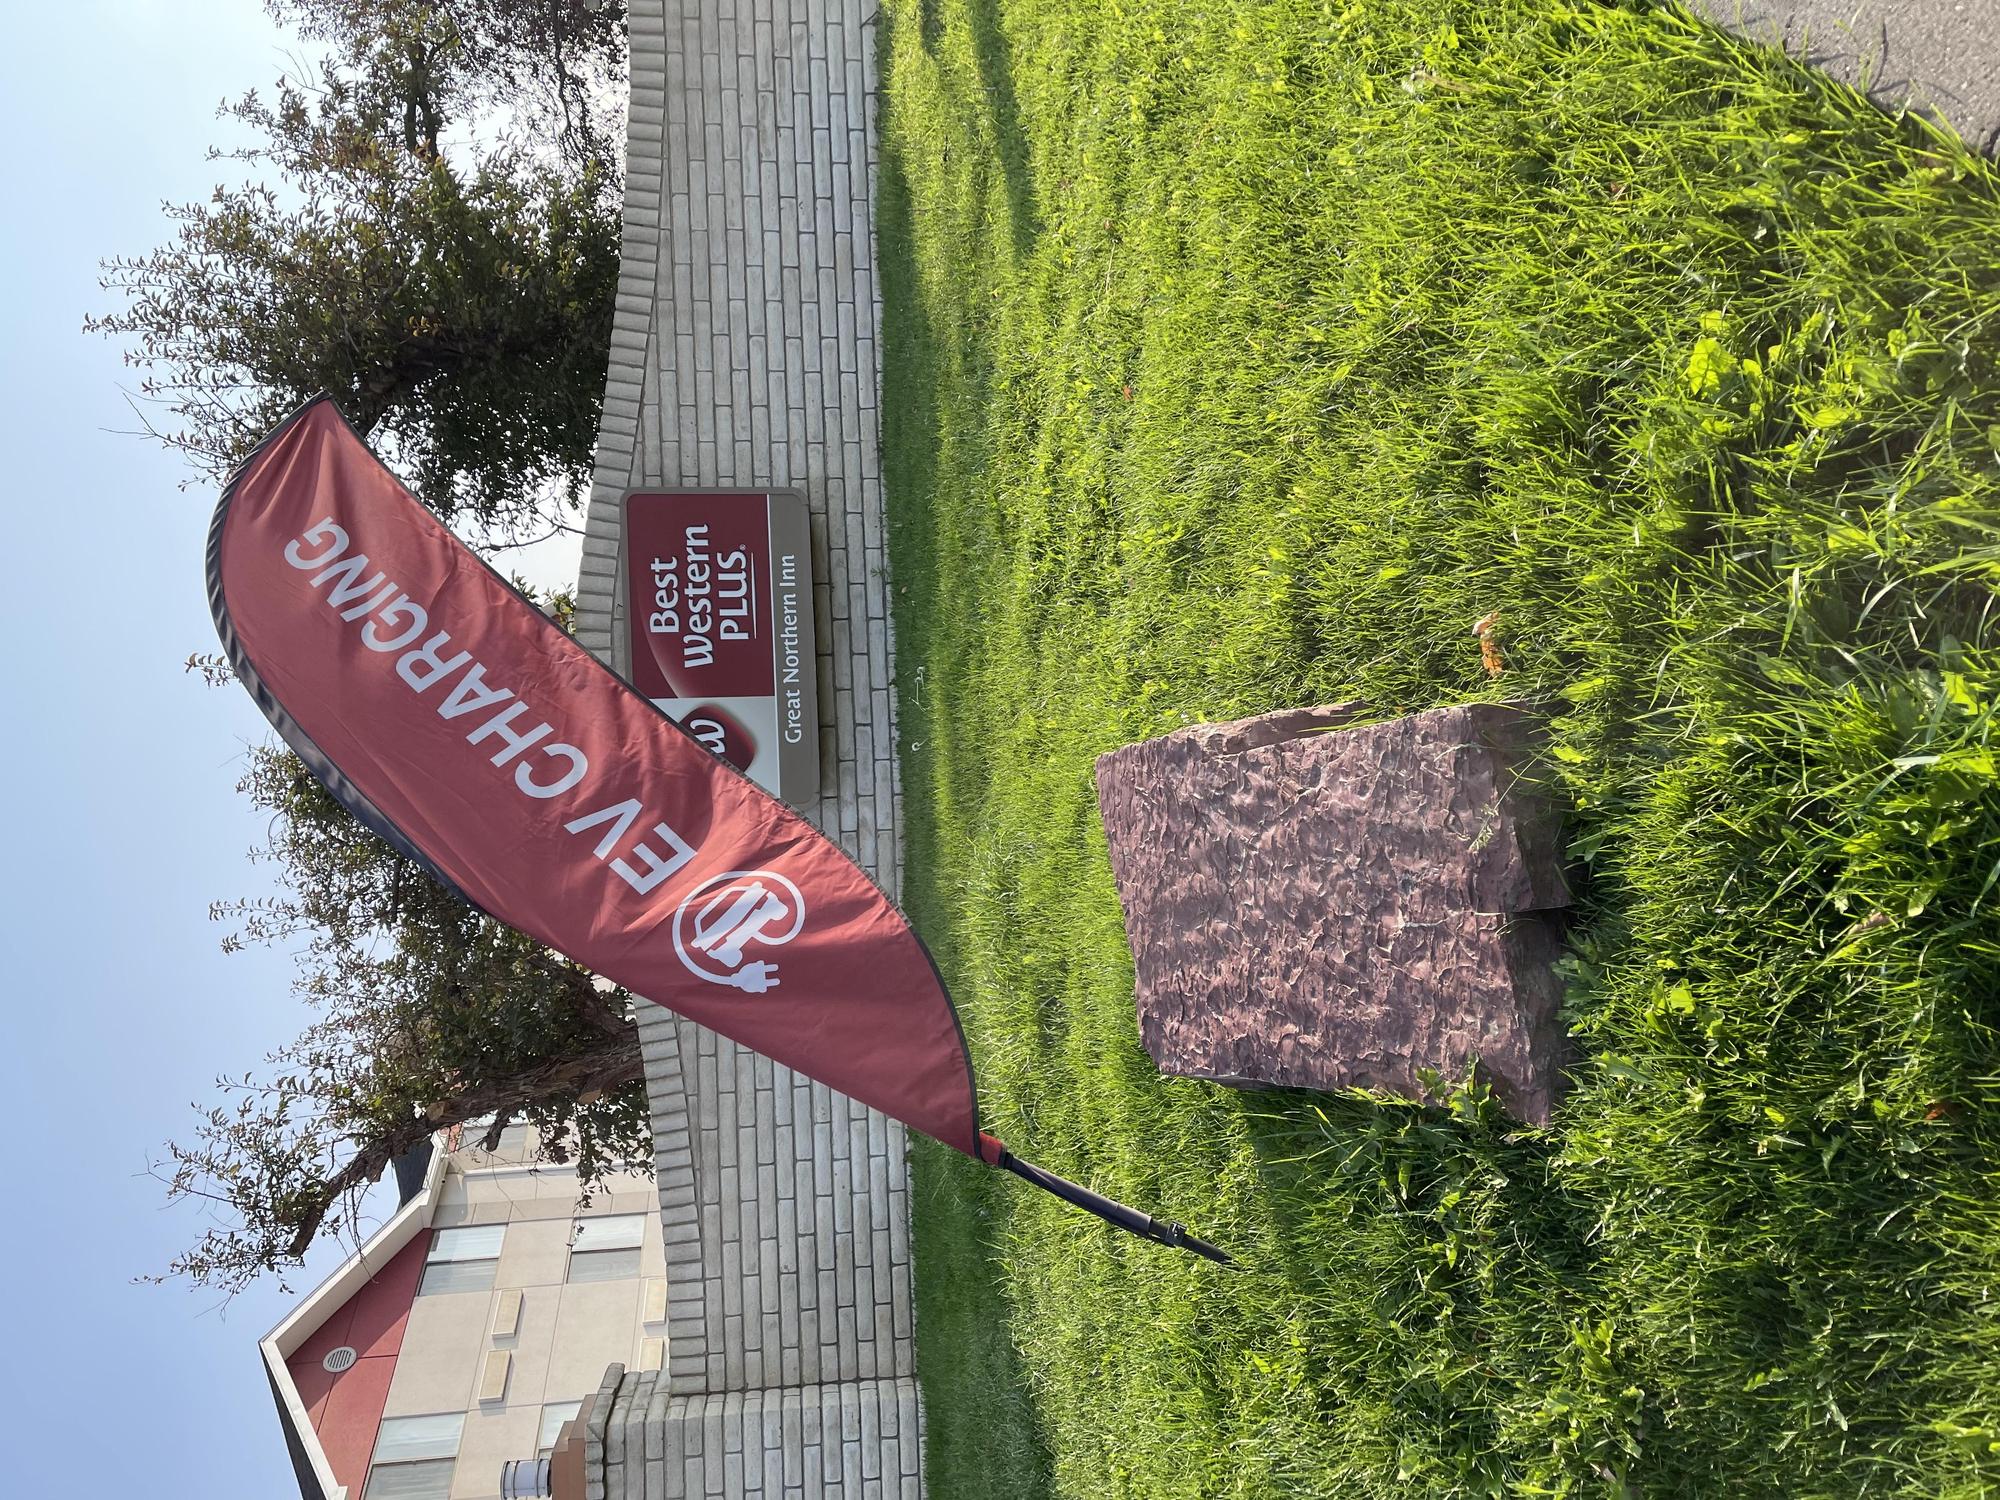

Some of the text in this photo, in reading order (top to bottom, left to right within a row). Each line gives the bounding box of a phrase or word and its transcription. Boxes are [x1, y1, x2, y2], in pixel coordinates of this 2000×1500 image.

[649, 556, 680, 633] Best
[683, 524, 714, 668] Western
[779, 554, 802, 744] Great Northern Inn
[284, 516, 698, 895] EV CHARGING
